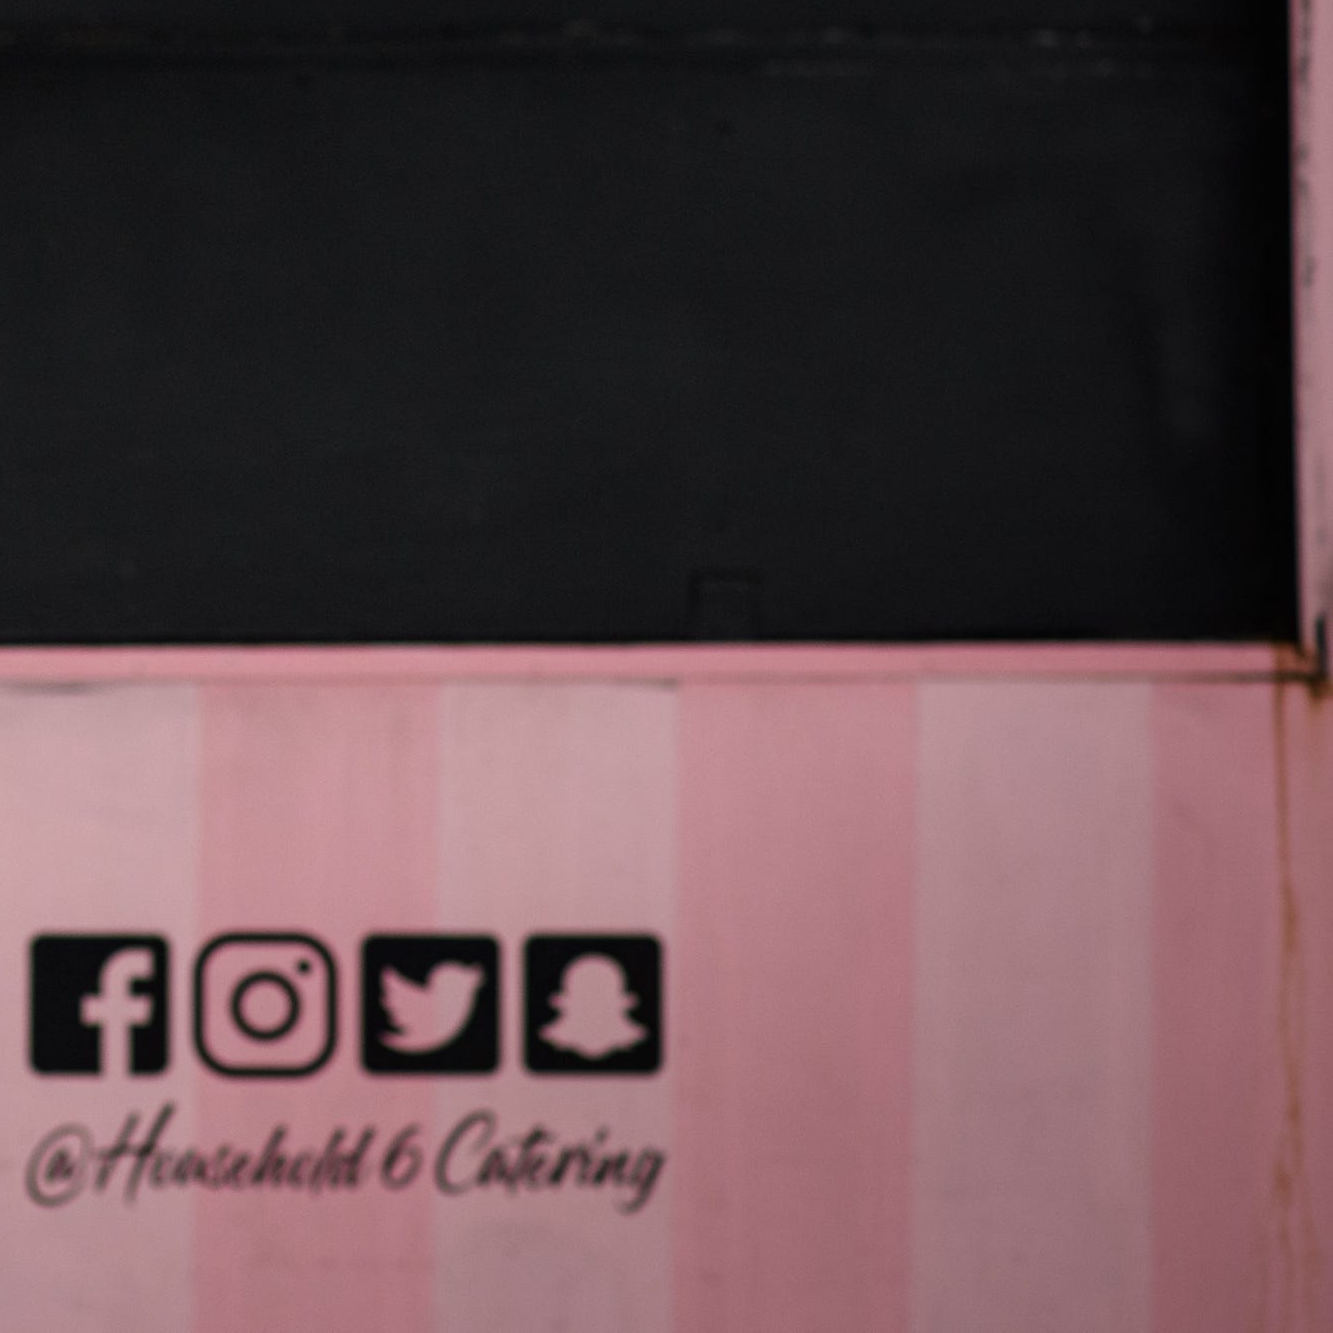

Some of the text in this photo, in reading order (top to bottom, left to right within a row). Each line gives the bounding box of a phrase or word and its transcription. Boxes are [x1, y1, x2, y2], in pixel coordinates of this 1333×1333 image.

[27, 1100, 668, 1216] @Household 6 Catering
